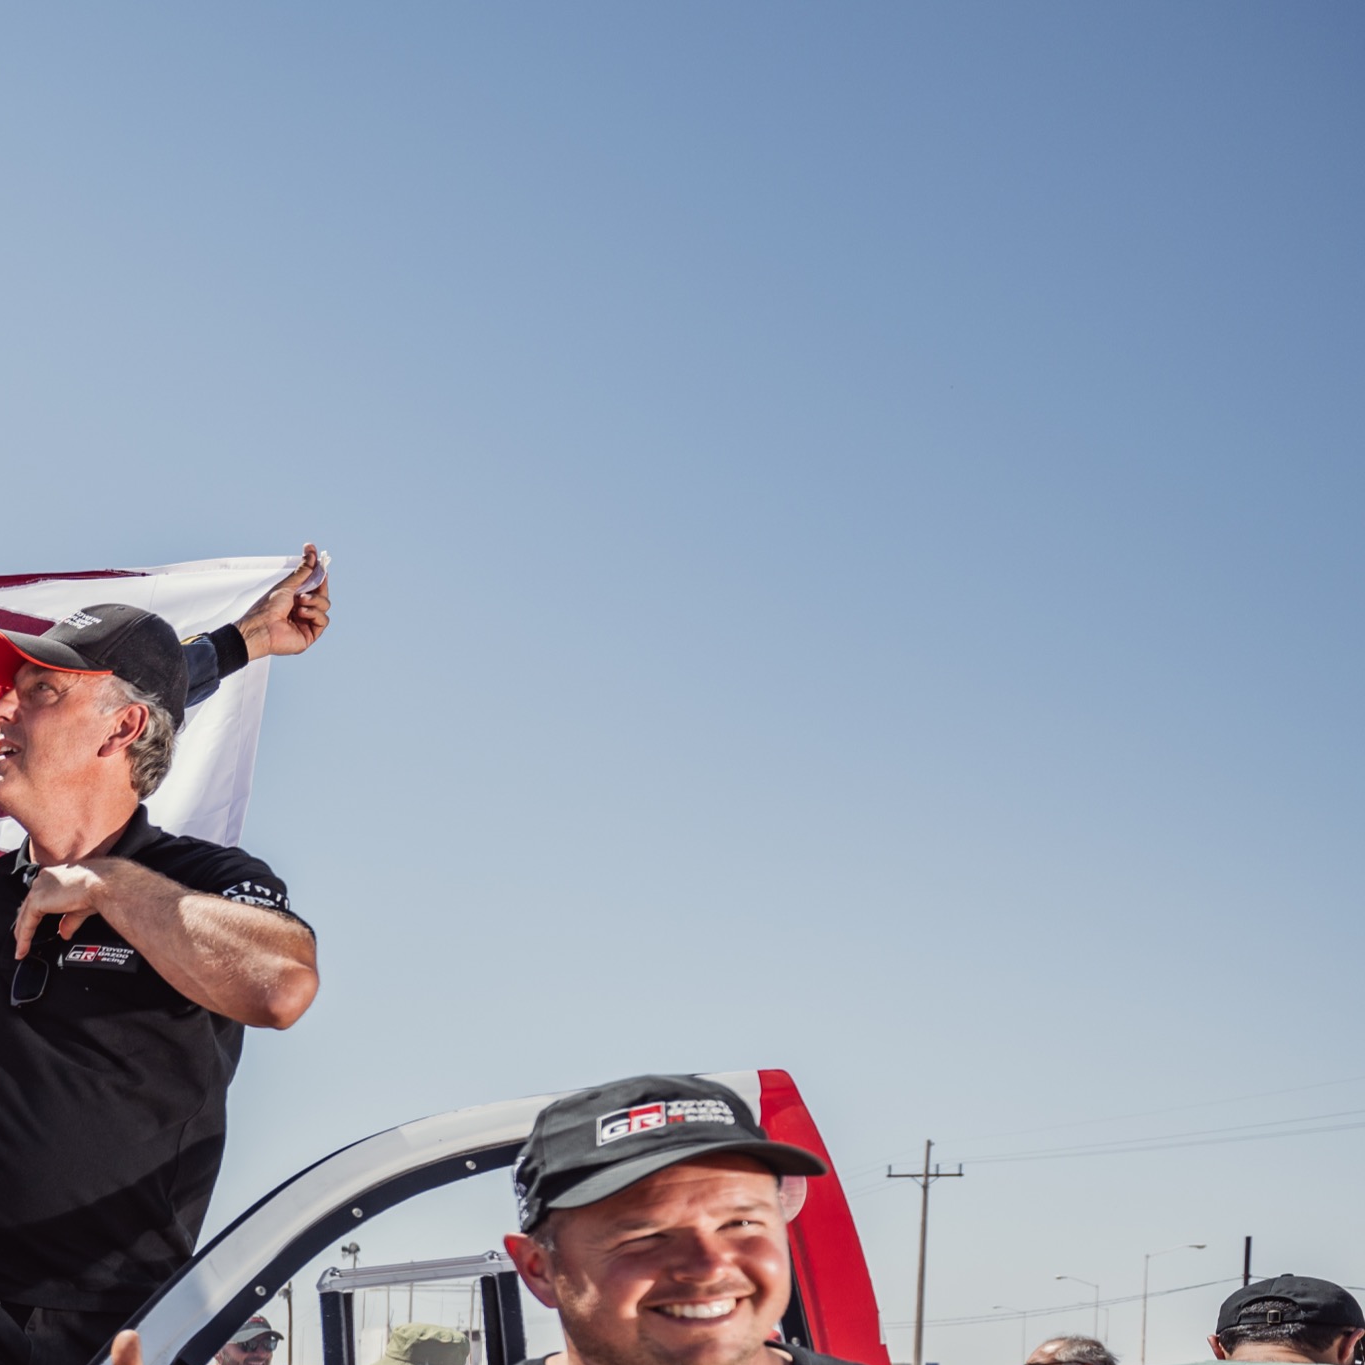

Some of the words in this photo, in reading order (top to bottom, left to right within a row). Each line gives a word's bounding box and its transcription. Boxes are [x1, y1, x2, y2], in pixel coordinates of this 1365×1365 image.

[98, 951, 129, 960] GAZOO
[100, 946, 134, 955] TOYOTA
[69, 950, 98, 962] GR
[601, 1113, 661, 1140] GR
